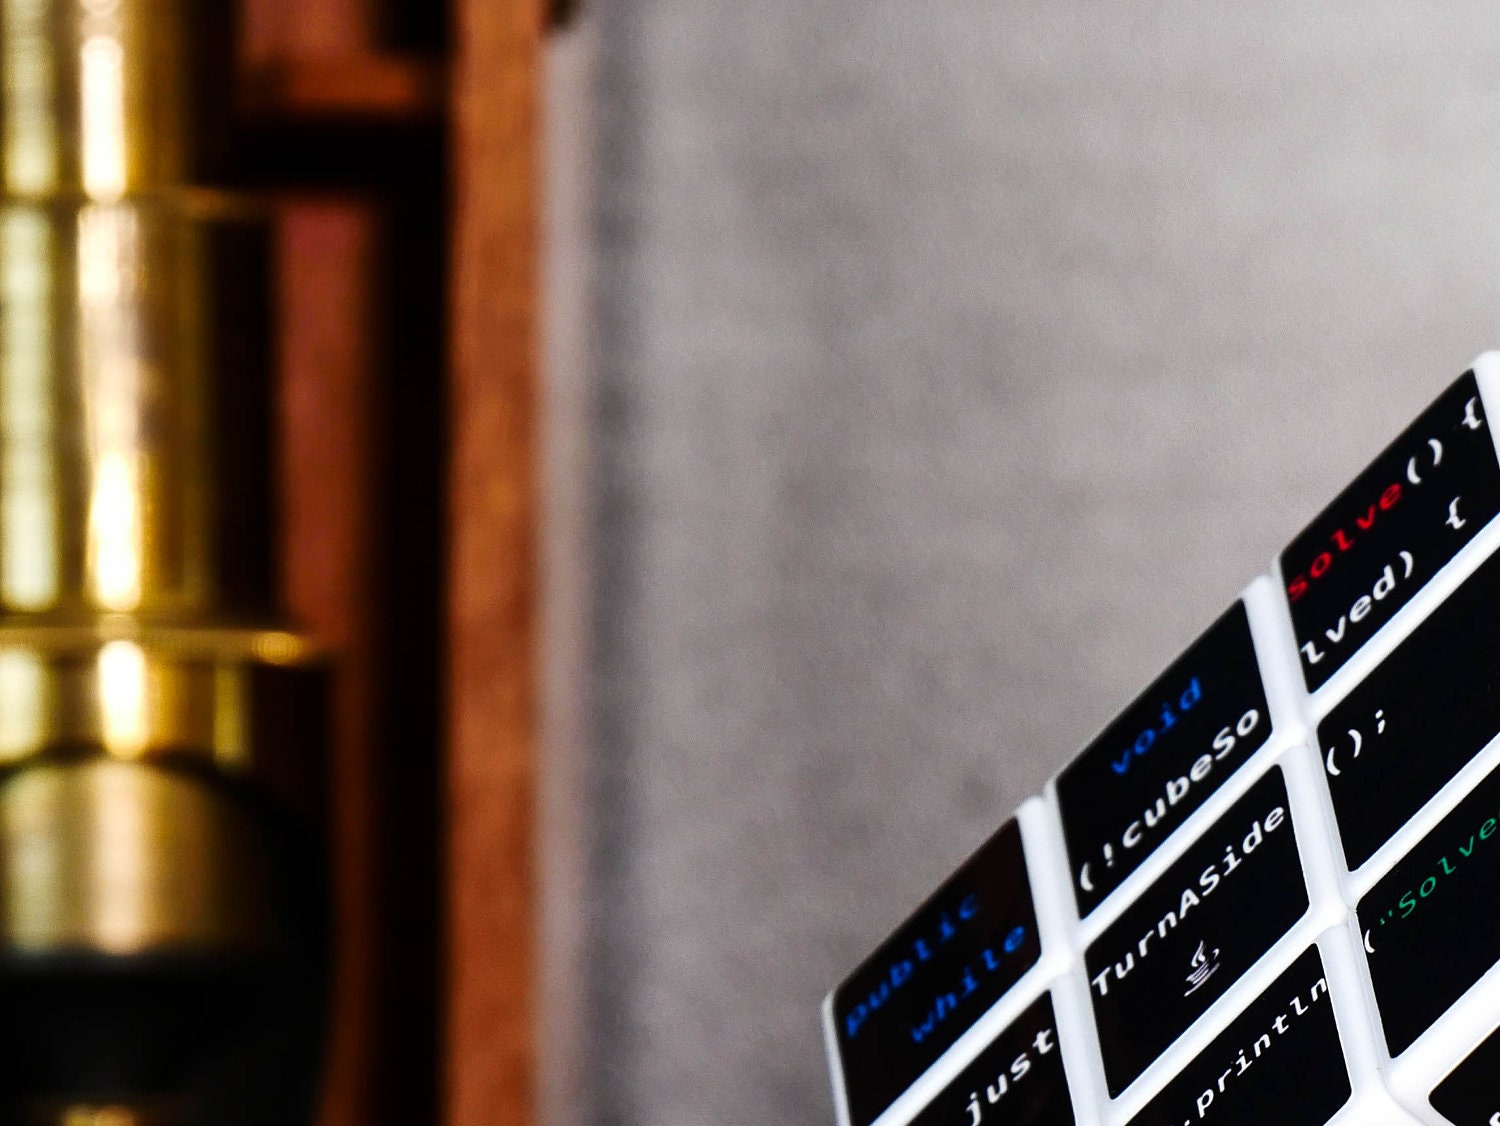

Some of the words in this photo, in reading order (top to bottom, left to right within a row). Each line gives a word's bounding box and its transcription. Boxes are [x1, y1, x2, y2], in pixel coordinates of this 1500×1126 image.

[1112, 676, 1203, 775] void
[1287, 438, 1443, 602] solve()
[910, 925, 1026, 1044] while
[1300, 550, 1413, 664] lved)
[1091, 806, 1284, 997] TurnASide
[1326, 709, 1386, 776] ();
